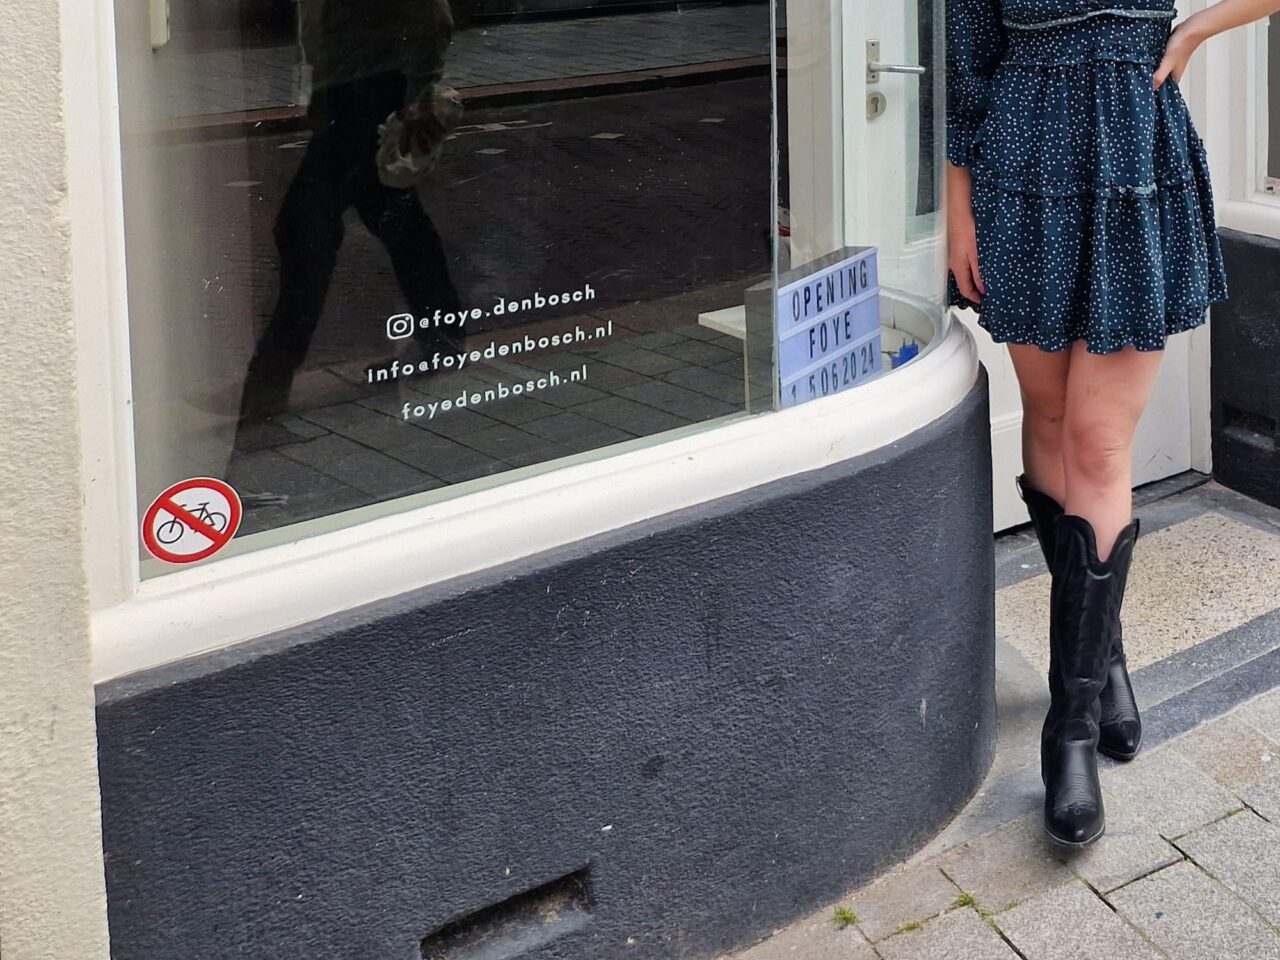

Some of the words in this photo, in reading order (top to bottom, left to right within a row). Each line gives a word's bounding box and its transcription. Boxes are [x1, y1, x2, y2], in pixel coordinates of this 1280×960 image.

[419, 284, 596, 329] @foye.denbosch
[791, 259, 867, 322] OPENING
[367, 319, 613, 383] info@foyedenbosch.nl
[809, 310, 852, 360] FOYE
[401, 364, 588, 420] foyedenbosch.nl
